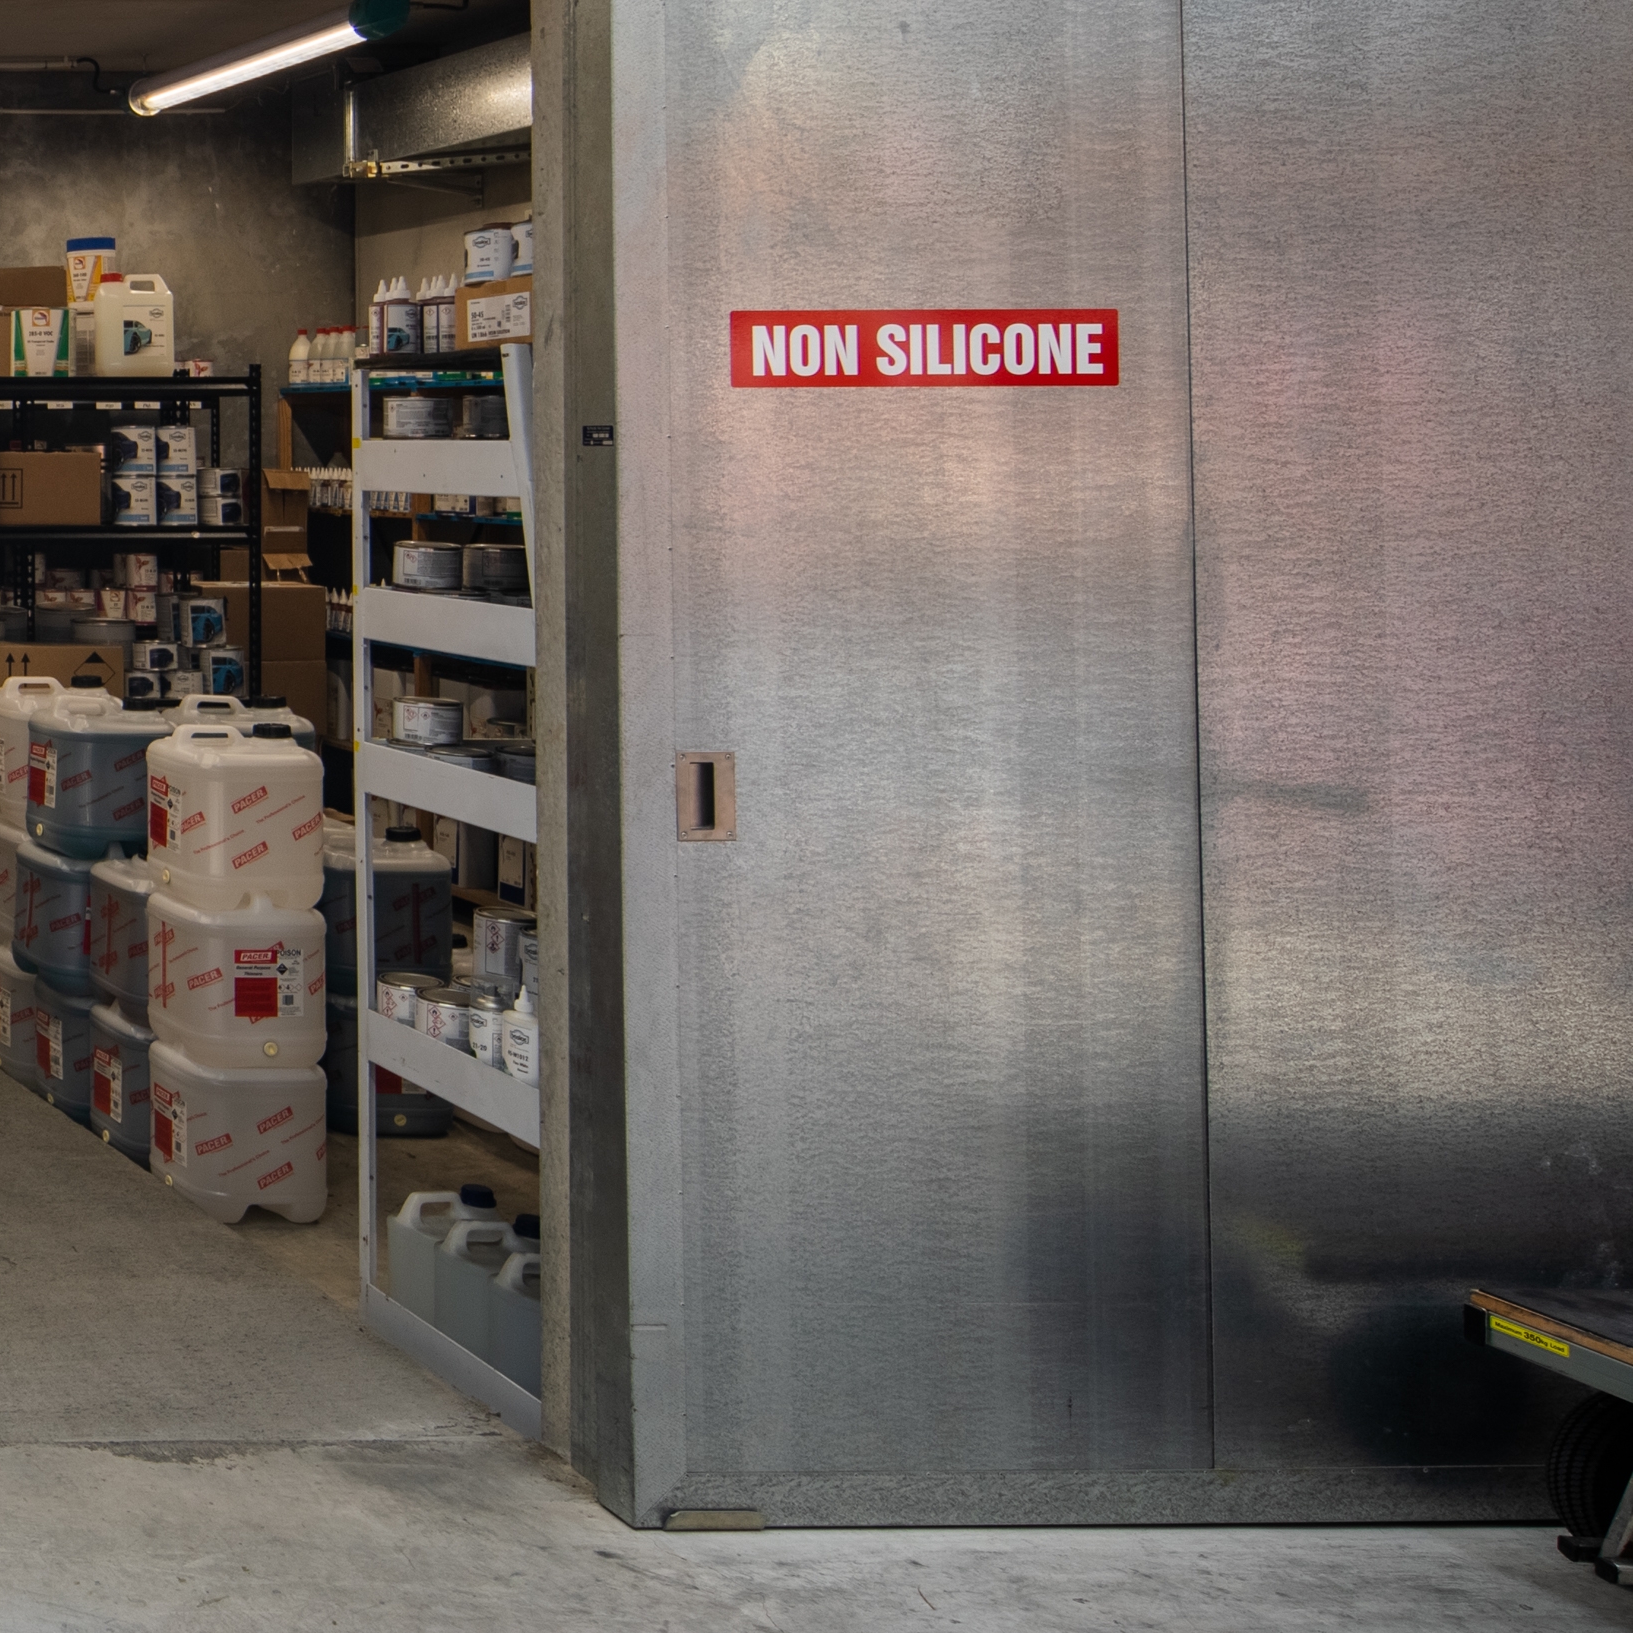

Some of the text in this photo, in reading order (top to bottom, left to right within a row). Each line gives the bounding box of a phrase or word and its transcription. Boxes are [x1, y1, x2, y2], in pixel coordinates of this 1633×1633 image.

[751, 323, 1104, 377] NON SILICONE
[1495, 1321, 1565, 1353] Maximum 350kg Load
